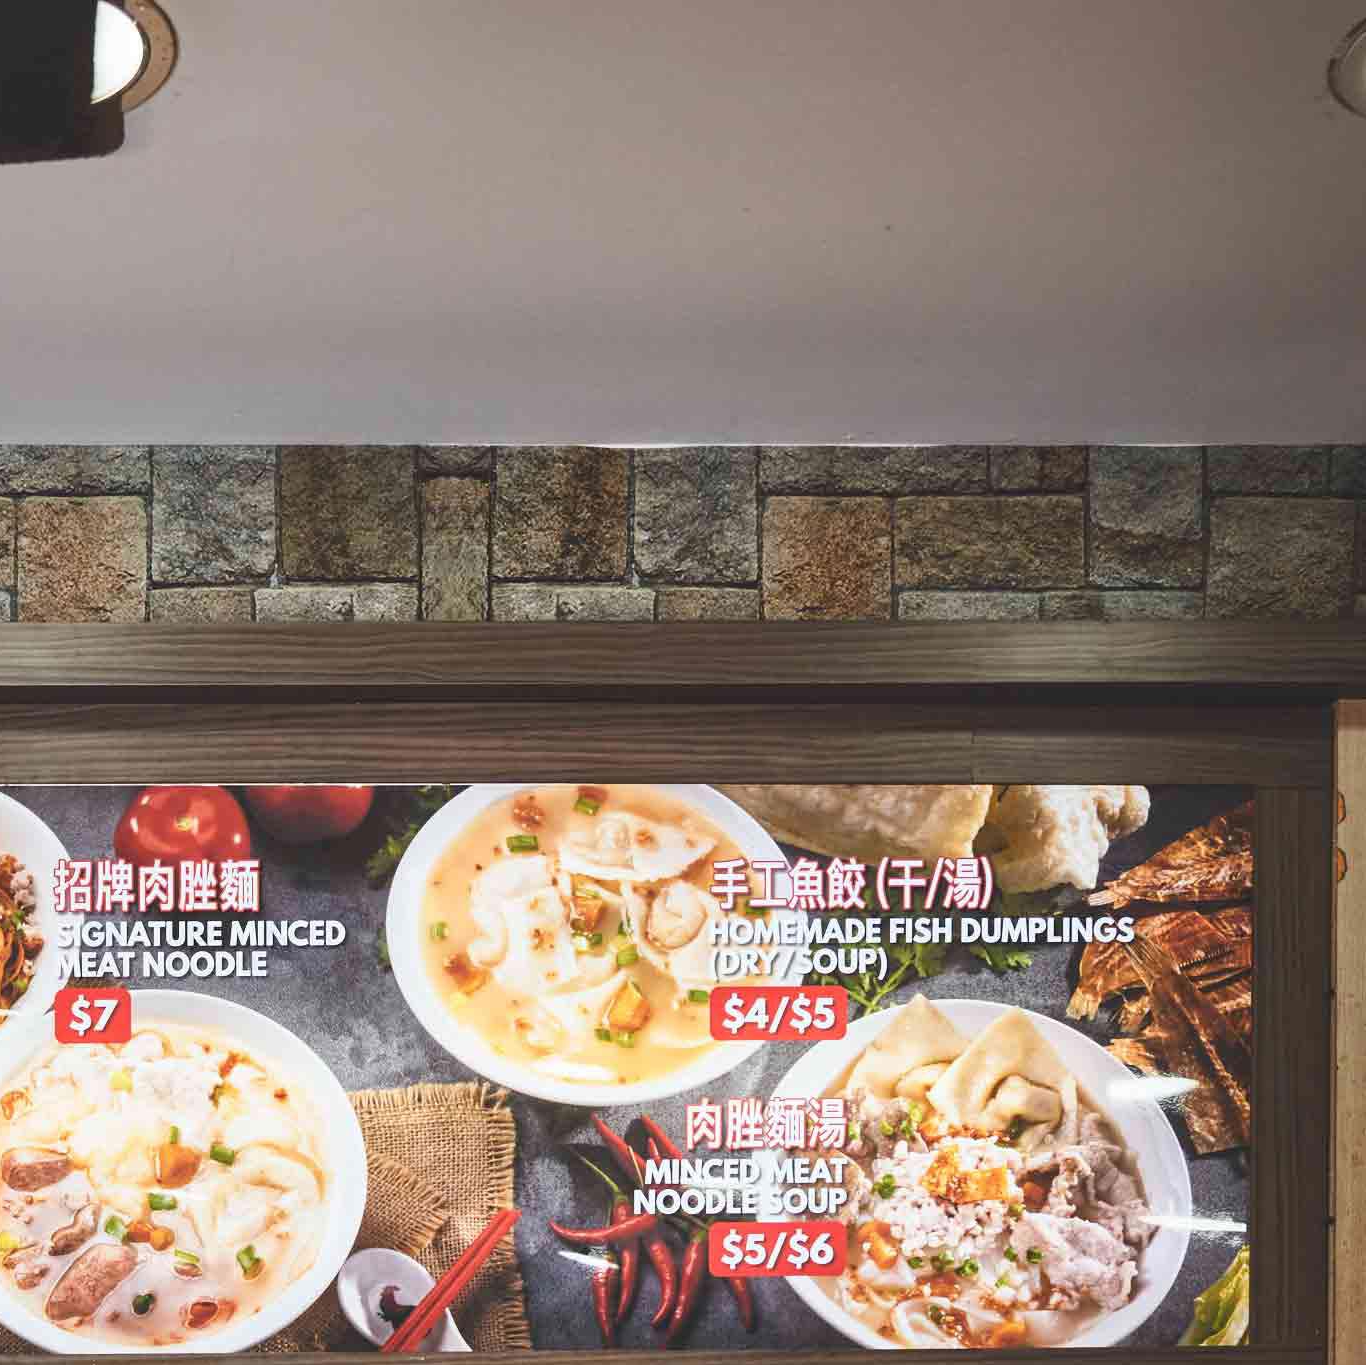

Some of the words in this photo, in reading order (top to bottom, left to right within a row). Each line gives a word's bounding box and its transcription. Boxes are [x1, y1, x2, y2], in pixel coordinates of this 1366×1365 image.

[54, 858, 261, 914] 招牌肉脞麵
[57, 920, 223, 948] SIGNATURE
[229, 920, 346, 947] MINCED
[709, 917, 883, 946] HOMEMADE
[889, 916, 954, 944] FISH
[960, 916, 1135, 944] DUMPLINGS
[57, 951, 137, 978] MEAT
[142, 951, 268, 977] NOODLE
[710, 947, 888, 982] (DRY/SOUP)
[68, 994, 119, 1036] $7
[722, 992, 836, 1034] $4/$5
[685, 1097, 847, 1150] 肉脞麵湯
[644, 1158, 761, 1186] MINCED
[768, 1158, 848, 1185] MEAT
[633, 1189, 759, 1217] NOODLE
[766, 1189, 849, 1216] SOUP
[720, 1228, 835, 1270] $5/$6
